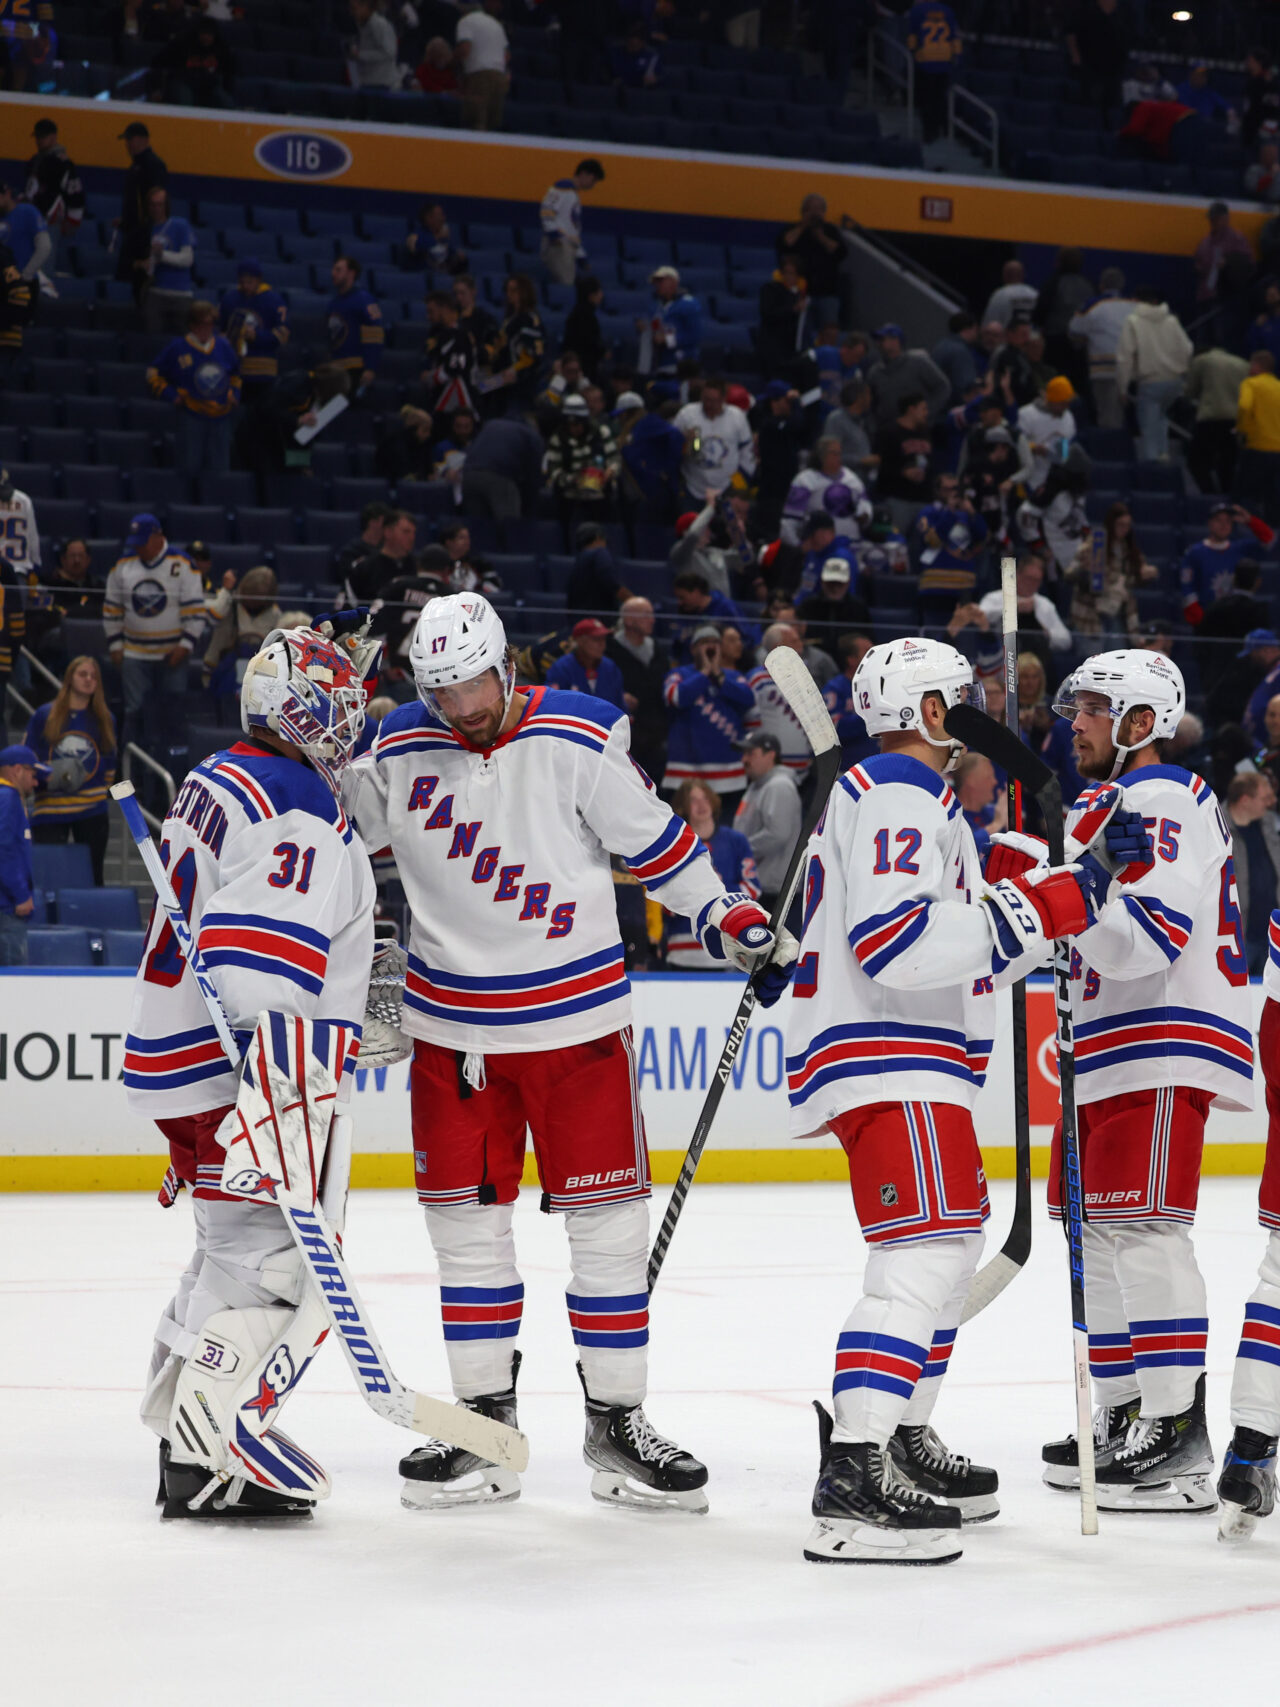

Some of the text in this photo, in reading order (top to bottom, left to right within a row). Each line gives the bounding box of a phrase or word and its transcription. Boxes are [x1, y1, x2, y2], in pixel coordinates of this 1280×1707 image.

[286, 139, 320, 170] 116
[170, 563, 181, 577] C
[431, 635, 447, 654] 17
[1145, 662, 1173, 675] Benjamin
[858, 691, 871, 711] 12
[408, 775, 577, 939] RANGERS
[873, 827, 922, 876] 12
[267, 842, 317, 895] 31
[718, 1015, 749, 1085] ALPHA
[565, 1167, 637, 1189] BAUER
[1085, 1189, 1142, 1204] BAUER
[1065, 1154, 1085, 1290] JETSPEED
[289, 1207, 392, 1395] WARRIOR
[201, 1345, 225, 1368] 31
[1133, 1452, 1168, 1475] BAUER
